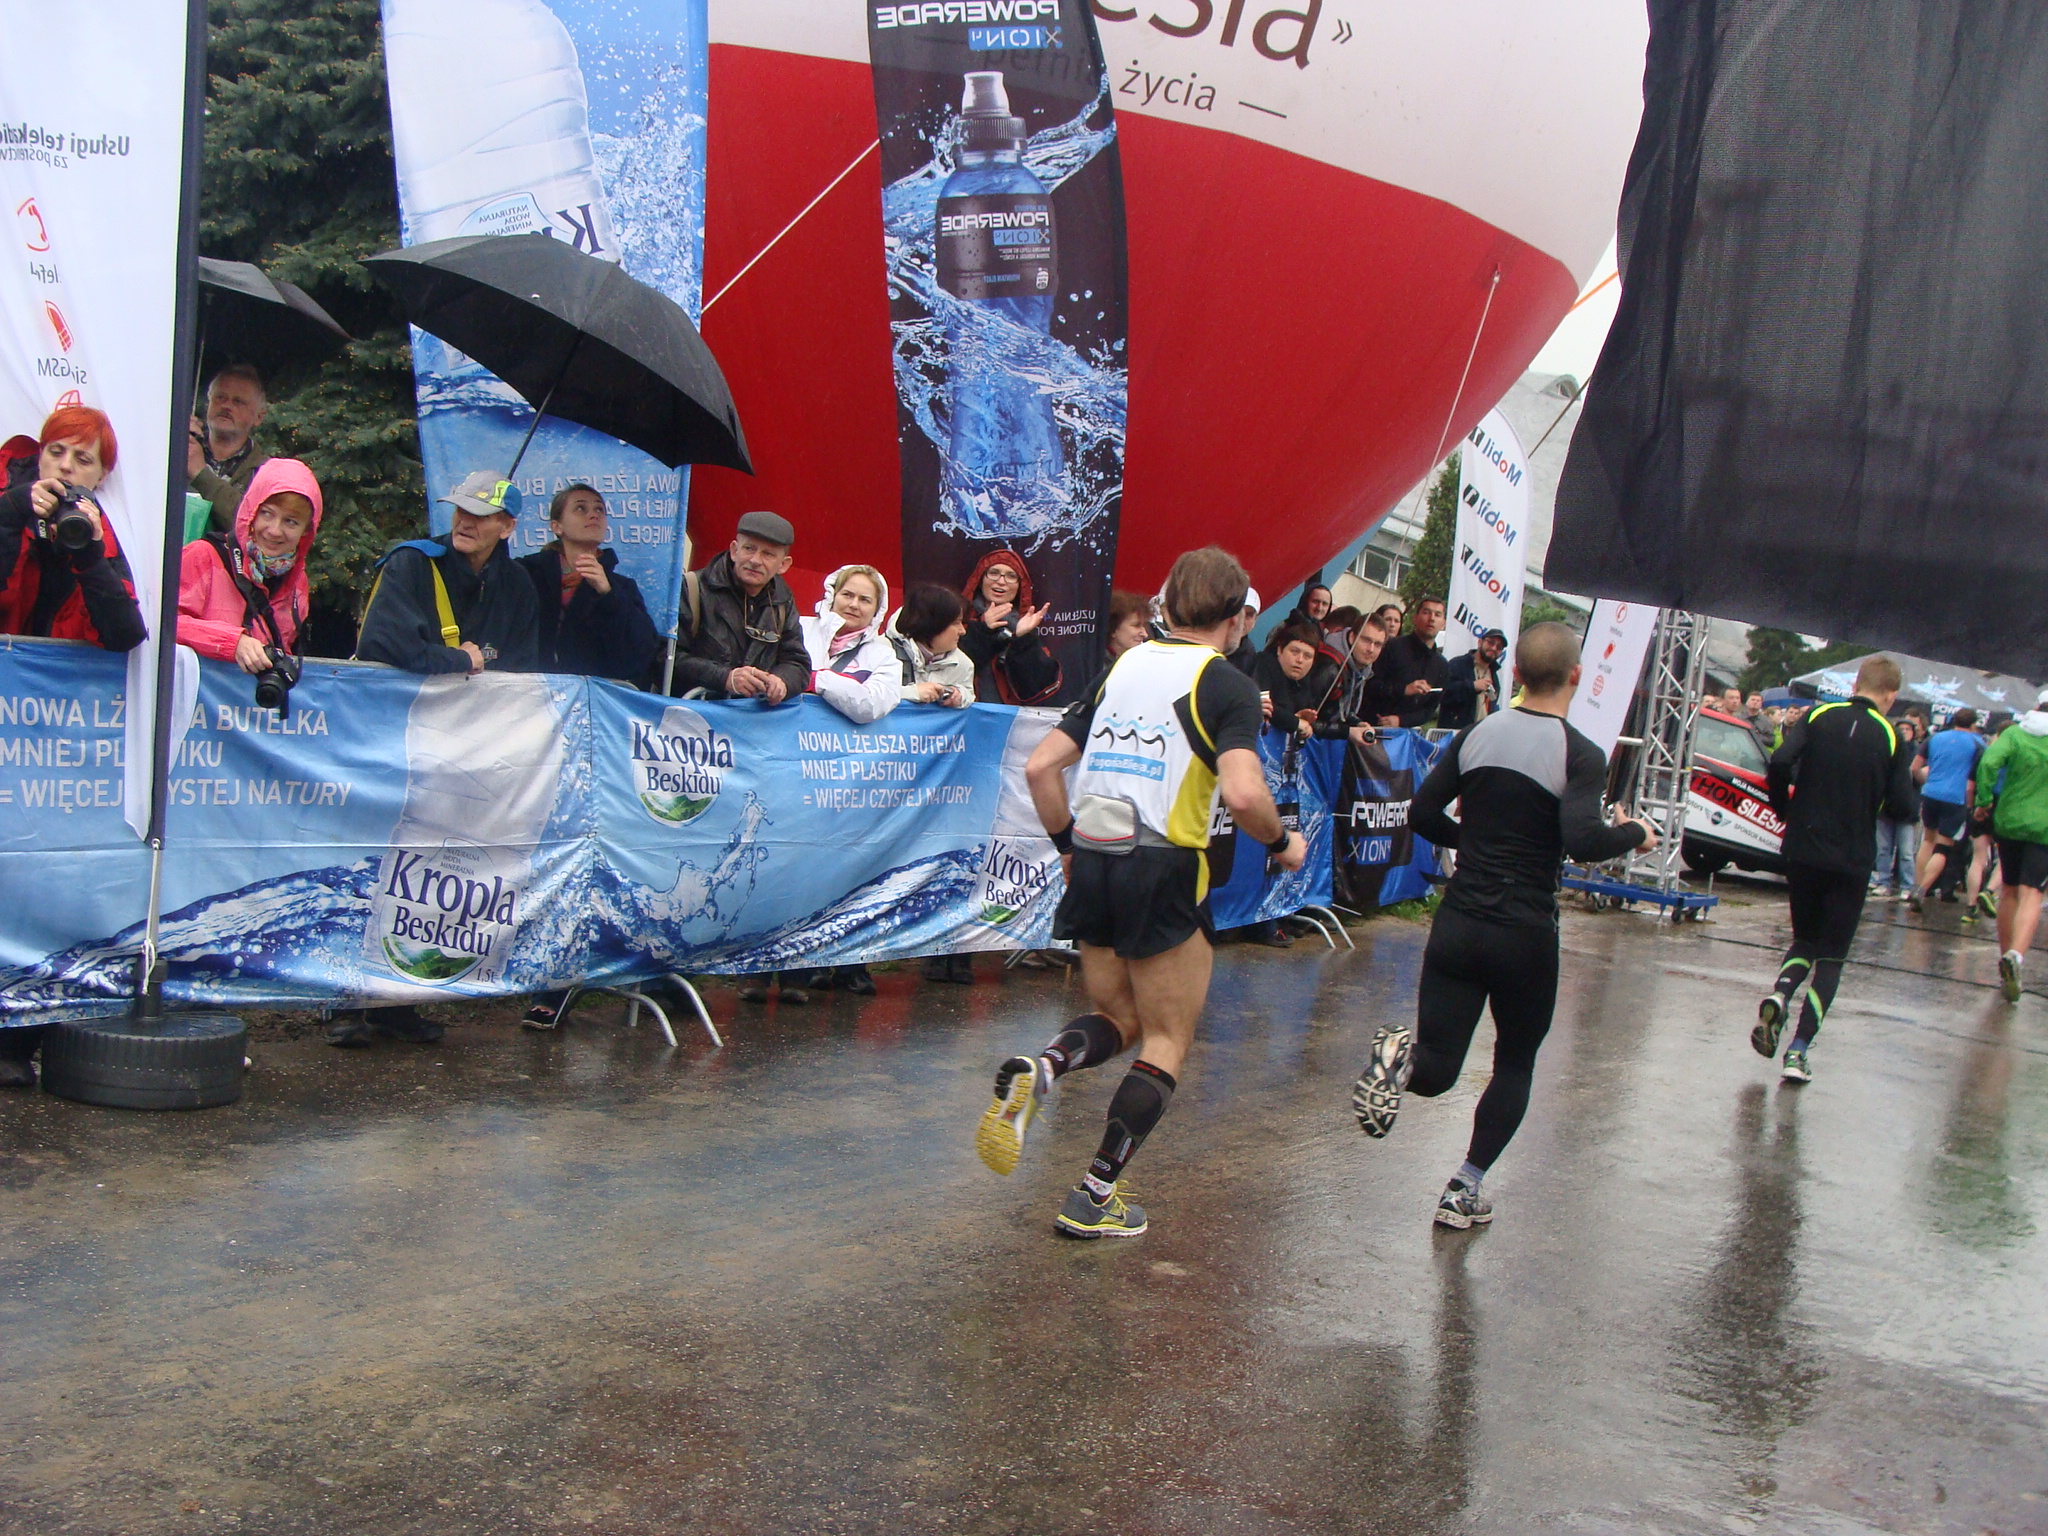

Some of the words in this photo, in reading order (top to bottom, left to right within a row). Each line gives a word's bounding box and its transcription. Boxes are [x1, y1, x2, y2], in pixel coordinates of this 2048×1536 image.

[1119, 59, 1217, 112] życia
[233, 547, 243, 575] Canon
[0, 697, 86, 728] NOWA
[216, 704, 329, 736] BUTELKA
[0, 737, 87, 768] MNIEJ
[631, 720, 735, 775] Kropla
[798, 730, 844, 753] NOWA
[844, 730, 908, 754] LŻEJSZA
[909, 734, 967, 755] BUTELKA
[645, 766, 721, 795] Beskidu
[801, 759, 847, 781] MNIEJ
[850, 760, 918, 782] PLASTIKU
[20, 778, 124, 814] WIĘCEJ
[248, 779, 353, 807] NATURY
[814, 787, 867, 813] WIĘCEJ
[869, 787, 923, 809] CZYSTEJ
[925, 785, 973, 807] NATURY
[384, 849, 517, 928] Kropla
[390, 904, 493, 957] Beskidu
